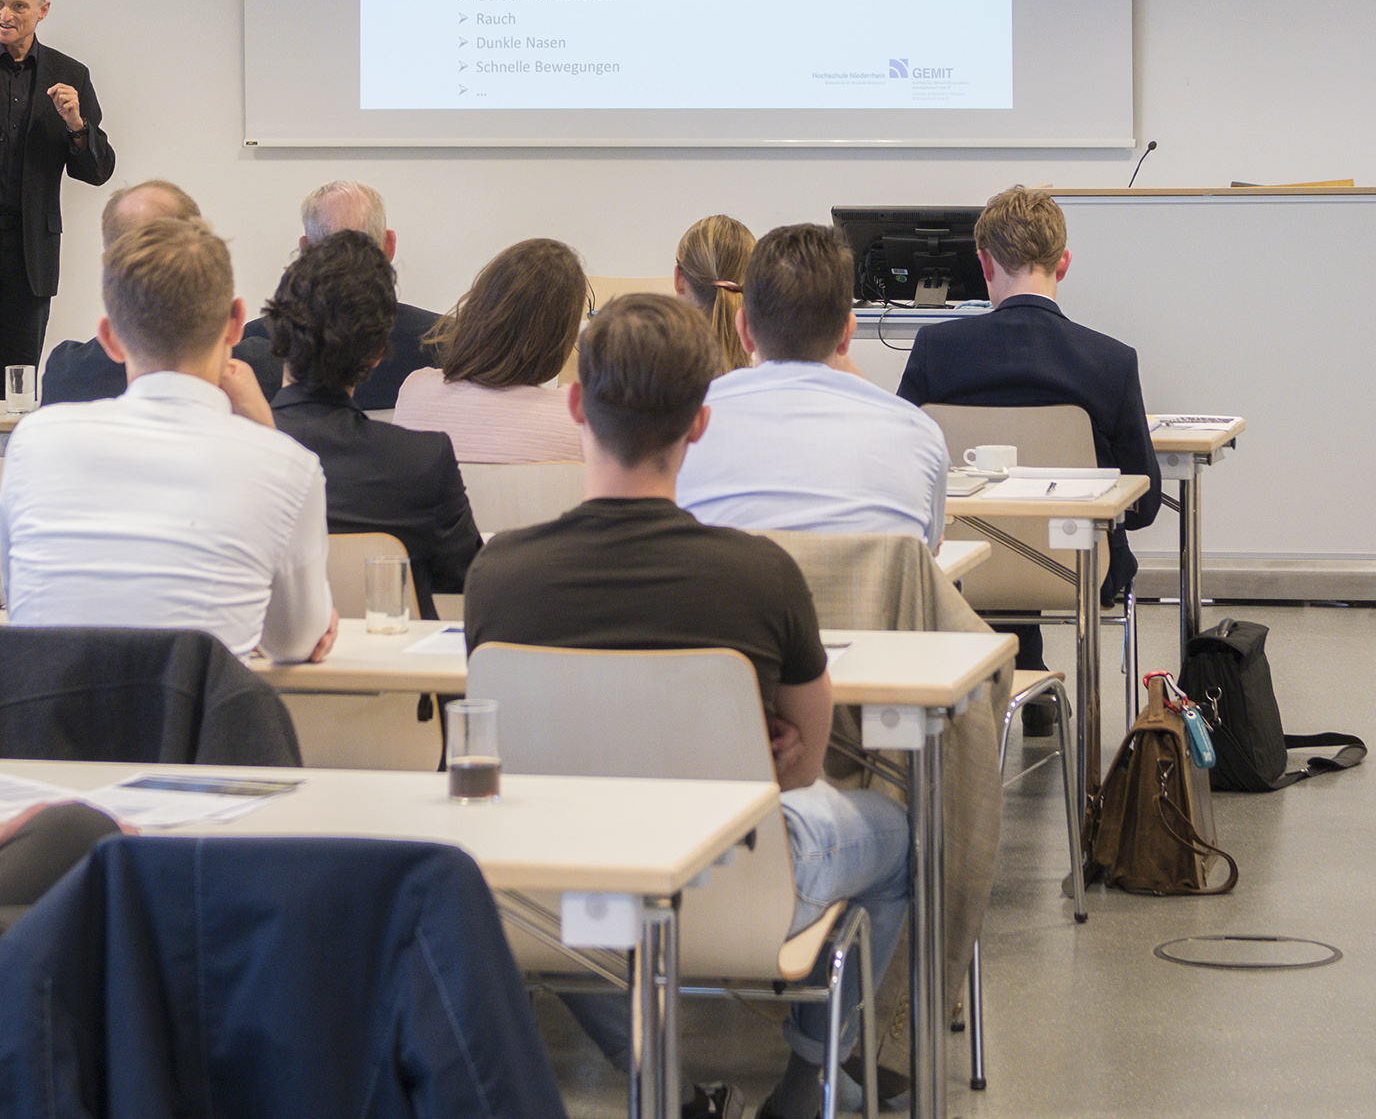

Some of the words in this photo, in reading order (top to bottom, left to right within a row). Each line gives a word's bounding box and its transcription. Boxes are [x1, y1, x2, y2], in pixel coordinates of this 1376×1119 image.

[476, 11, 517, 25] Rauch
[476, 35, 522, 49] Dunkle
[525, 36, 567, 49] Nasen
[476, 59, 531, 74] Schnelle
[534, 60, 621, 76] Bewegungen
[912, 67, 954, 79] GEMIT
